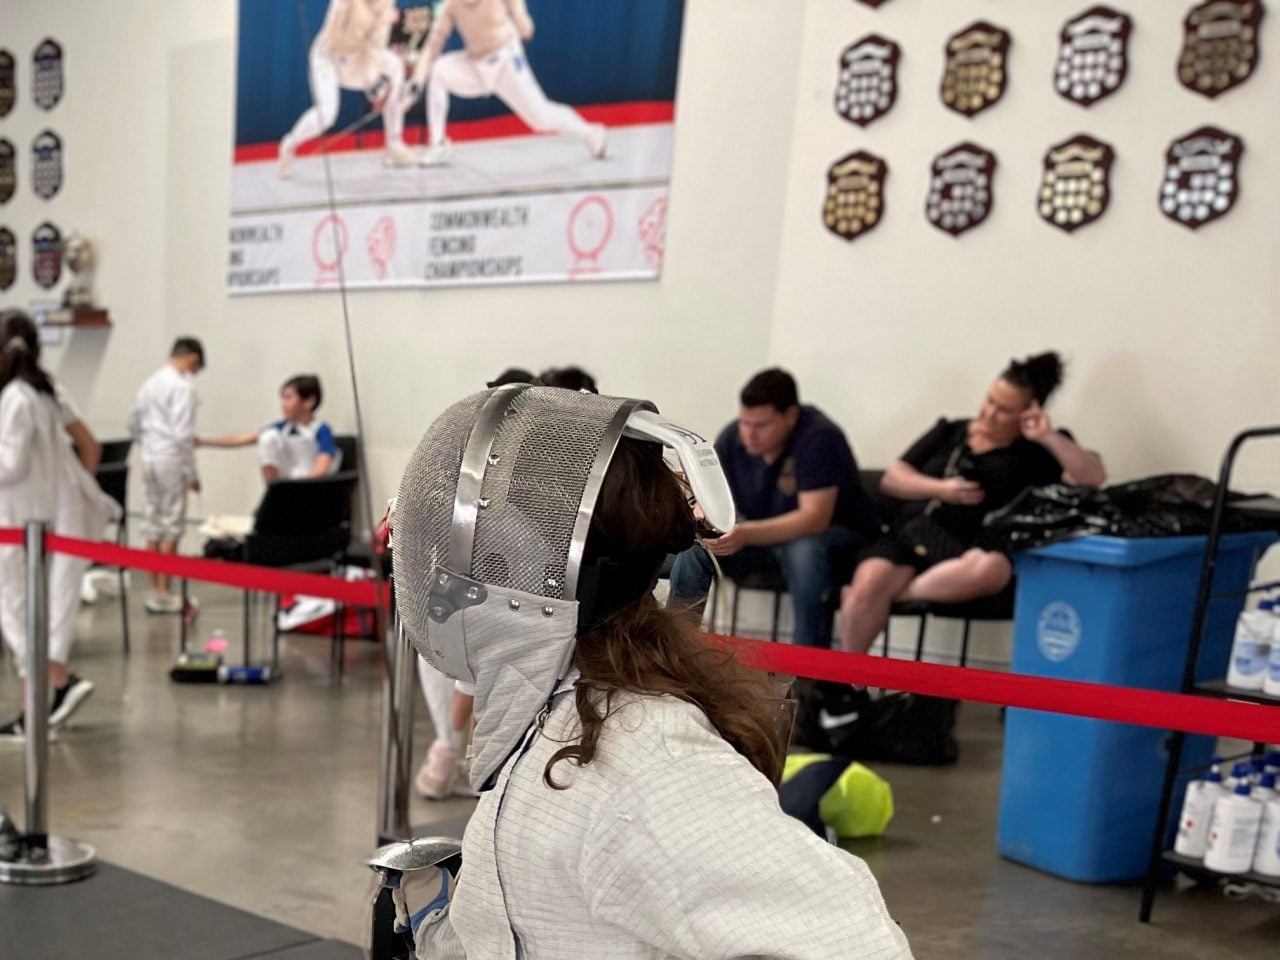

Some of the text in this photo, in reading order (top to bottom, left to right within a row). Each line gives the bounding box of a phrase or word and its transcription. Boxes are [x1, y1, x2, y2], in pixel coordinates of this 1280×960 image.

[429, 205, 530, 231] COMMONWEALTH
[427, 233, 478, 258] FENCING
[424, 254, 523, 281] CHAMPIONSHIPS
